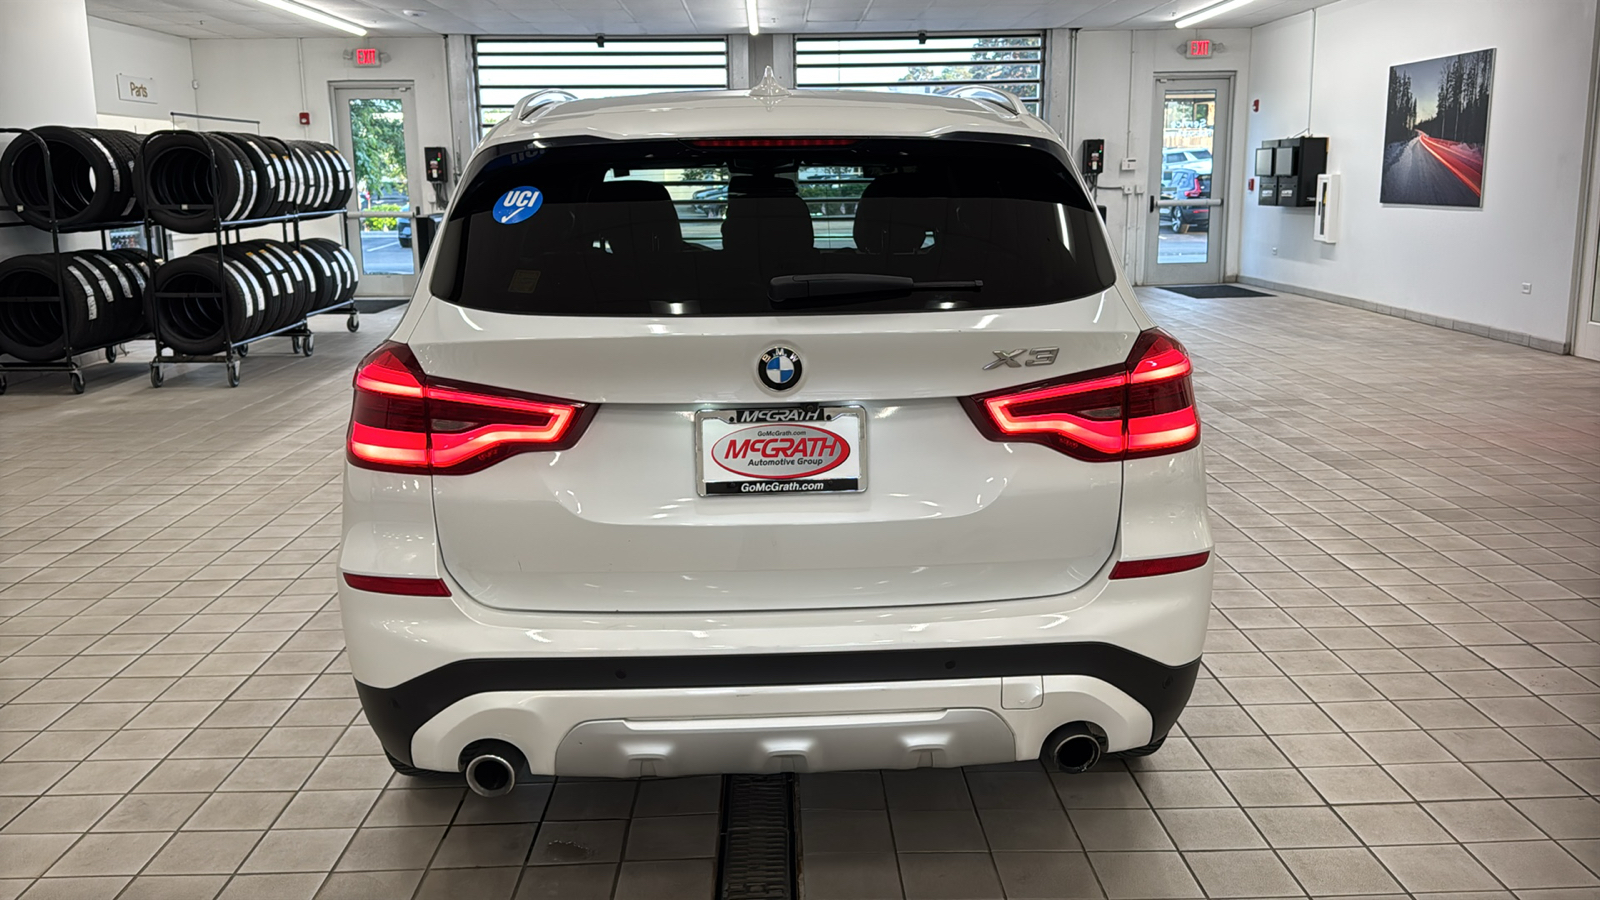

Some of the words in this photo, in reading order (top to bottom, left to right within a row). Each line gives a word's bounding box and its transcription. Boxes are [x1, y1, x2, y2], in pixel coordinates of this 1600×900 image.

[1190, 40, 1210, 56] EXIT
[356, 48, 376, 65] EXIT
[503, 190, 540, 208] UCI
[761, 348, 799, 363] BMW
[982, 346, 1060, 371] X3
[757, 429, 807, 437] GoMcGrath.com
[748, 458, 796, 467] Automotive
[797, 457, 824, 467] Group
[740, 482, 825, 493] GoMcGrath.com
